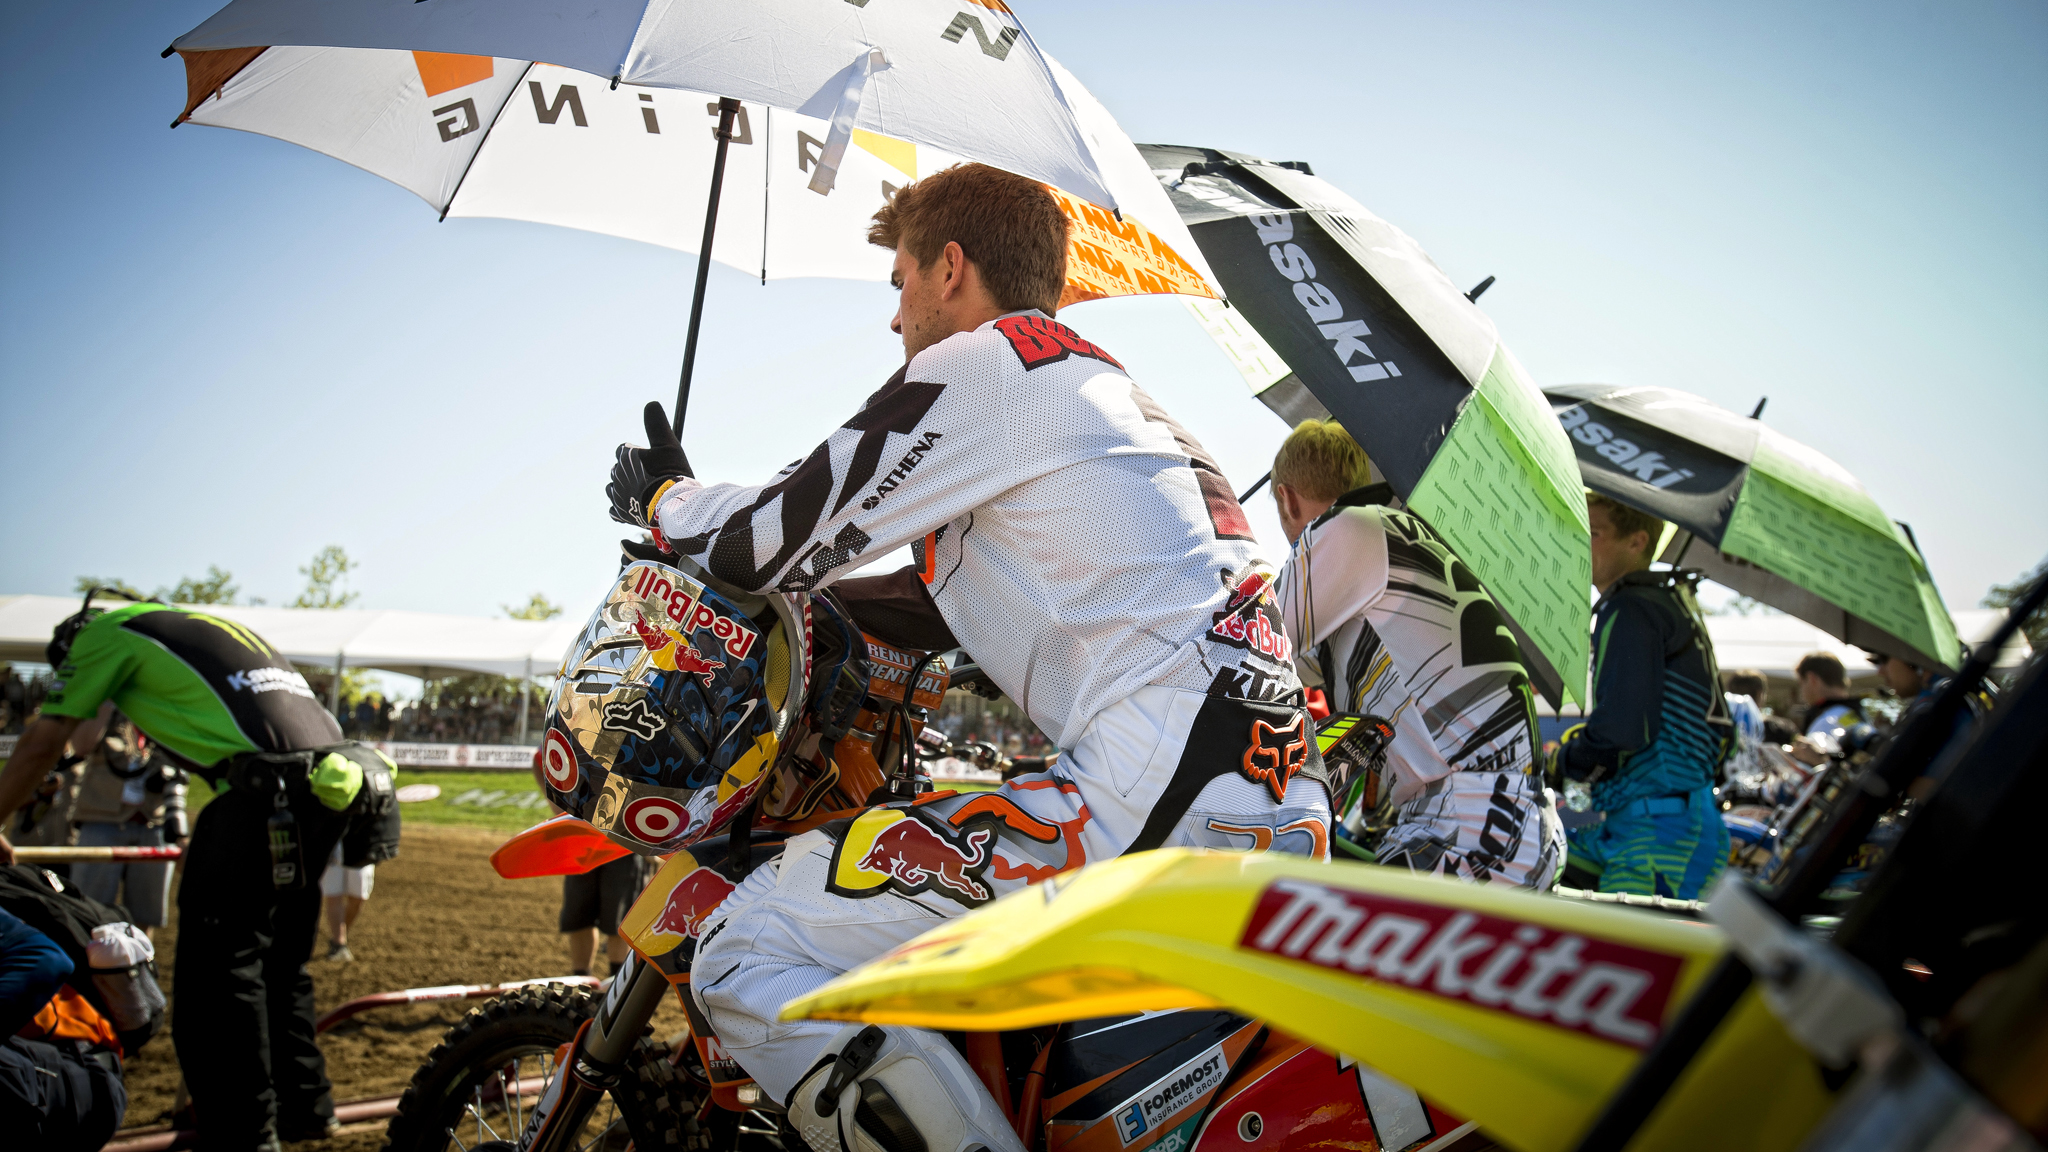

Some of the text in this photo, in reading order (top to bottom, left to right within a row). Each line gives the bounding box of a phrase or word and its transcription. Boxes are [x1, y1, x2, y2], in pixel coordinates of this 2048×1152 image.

[876, 431, 943, 499] ATHENA
[1143, 1055, 1220, 1116] FOREMOST
[1148, 1071, 1223, 1127] INSURANCE GROUP
